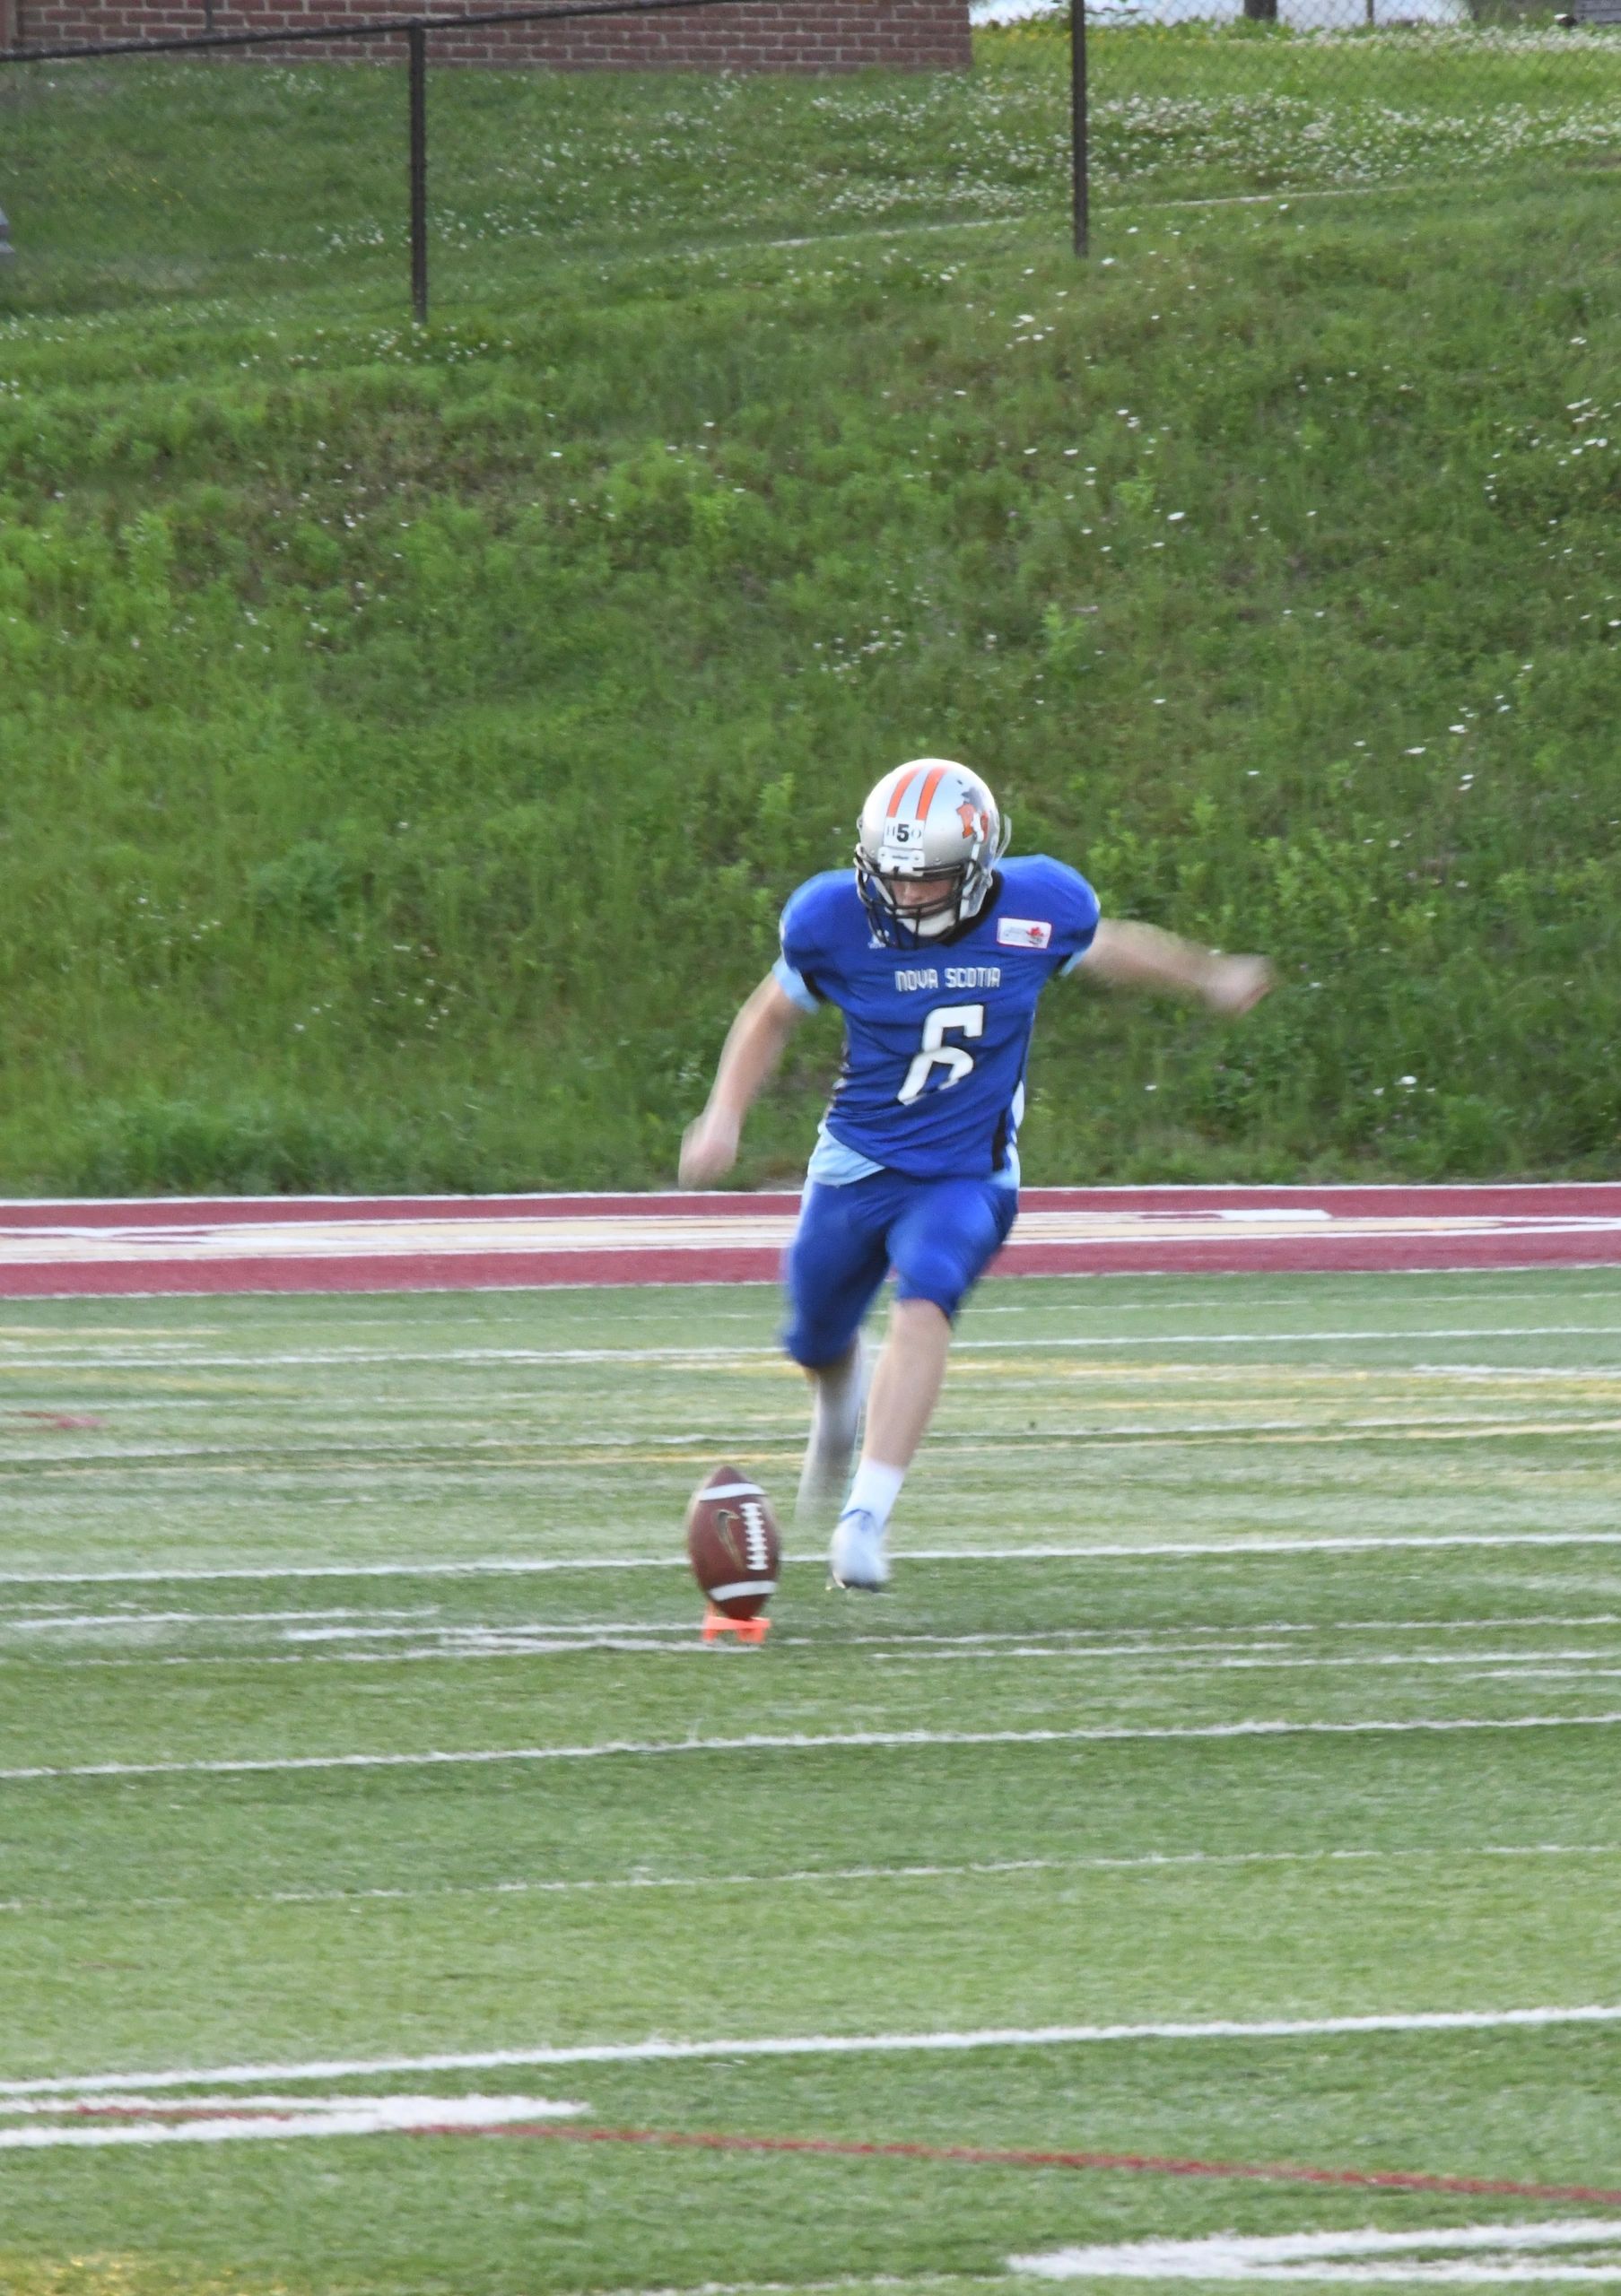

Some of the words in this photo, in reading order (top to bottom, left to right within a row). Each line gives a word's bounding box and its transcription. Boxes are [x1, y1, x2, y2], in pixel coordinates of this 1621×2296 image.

[894, 969, 938, 992] NOVA
[945, 967, 1001, 988] SCOTIA
[897, 1004, 984, 1106] 6
